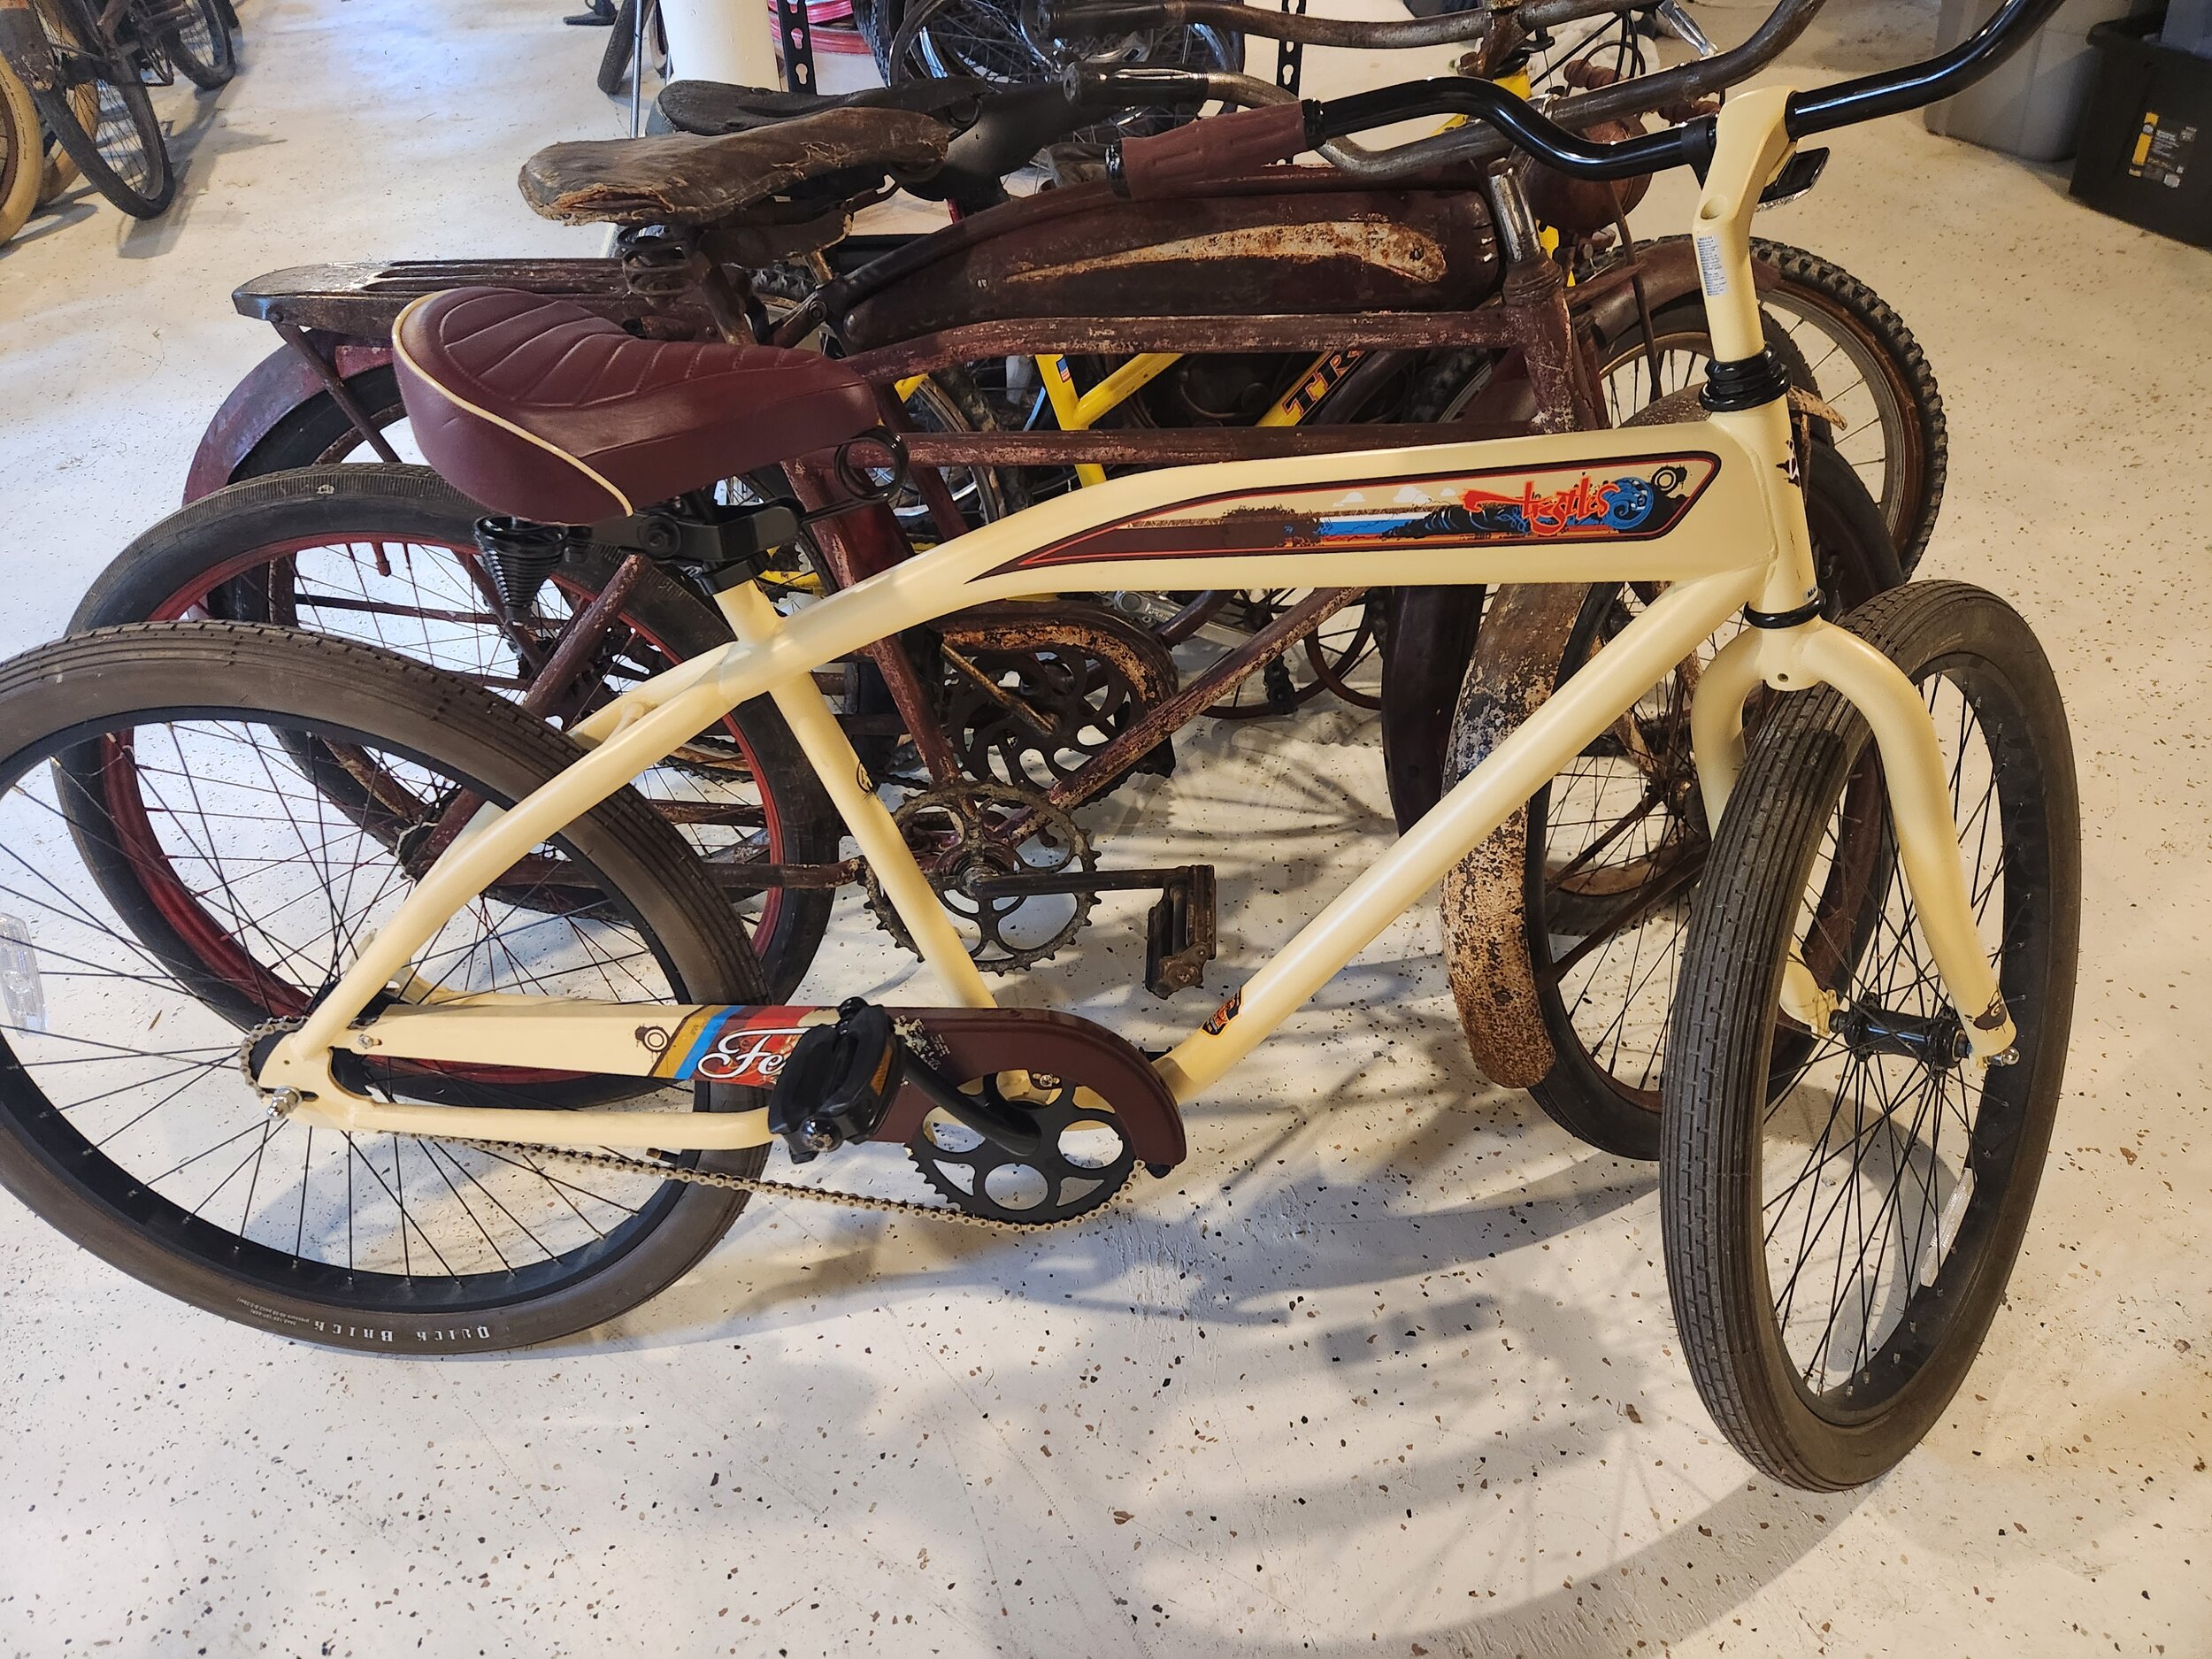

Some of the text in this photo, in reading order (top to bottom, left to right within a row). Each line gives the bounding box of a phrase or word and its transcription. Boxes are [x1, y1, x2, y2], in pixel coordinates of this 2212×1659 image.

[1282, 349, 1365, 417] TR
[697, 1027, 811, 1079] Fe
[314, 1321, 394, 1342] BRICK
